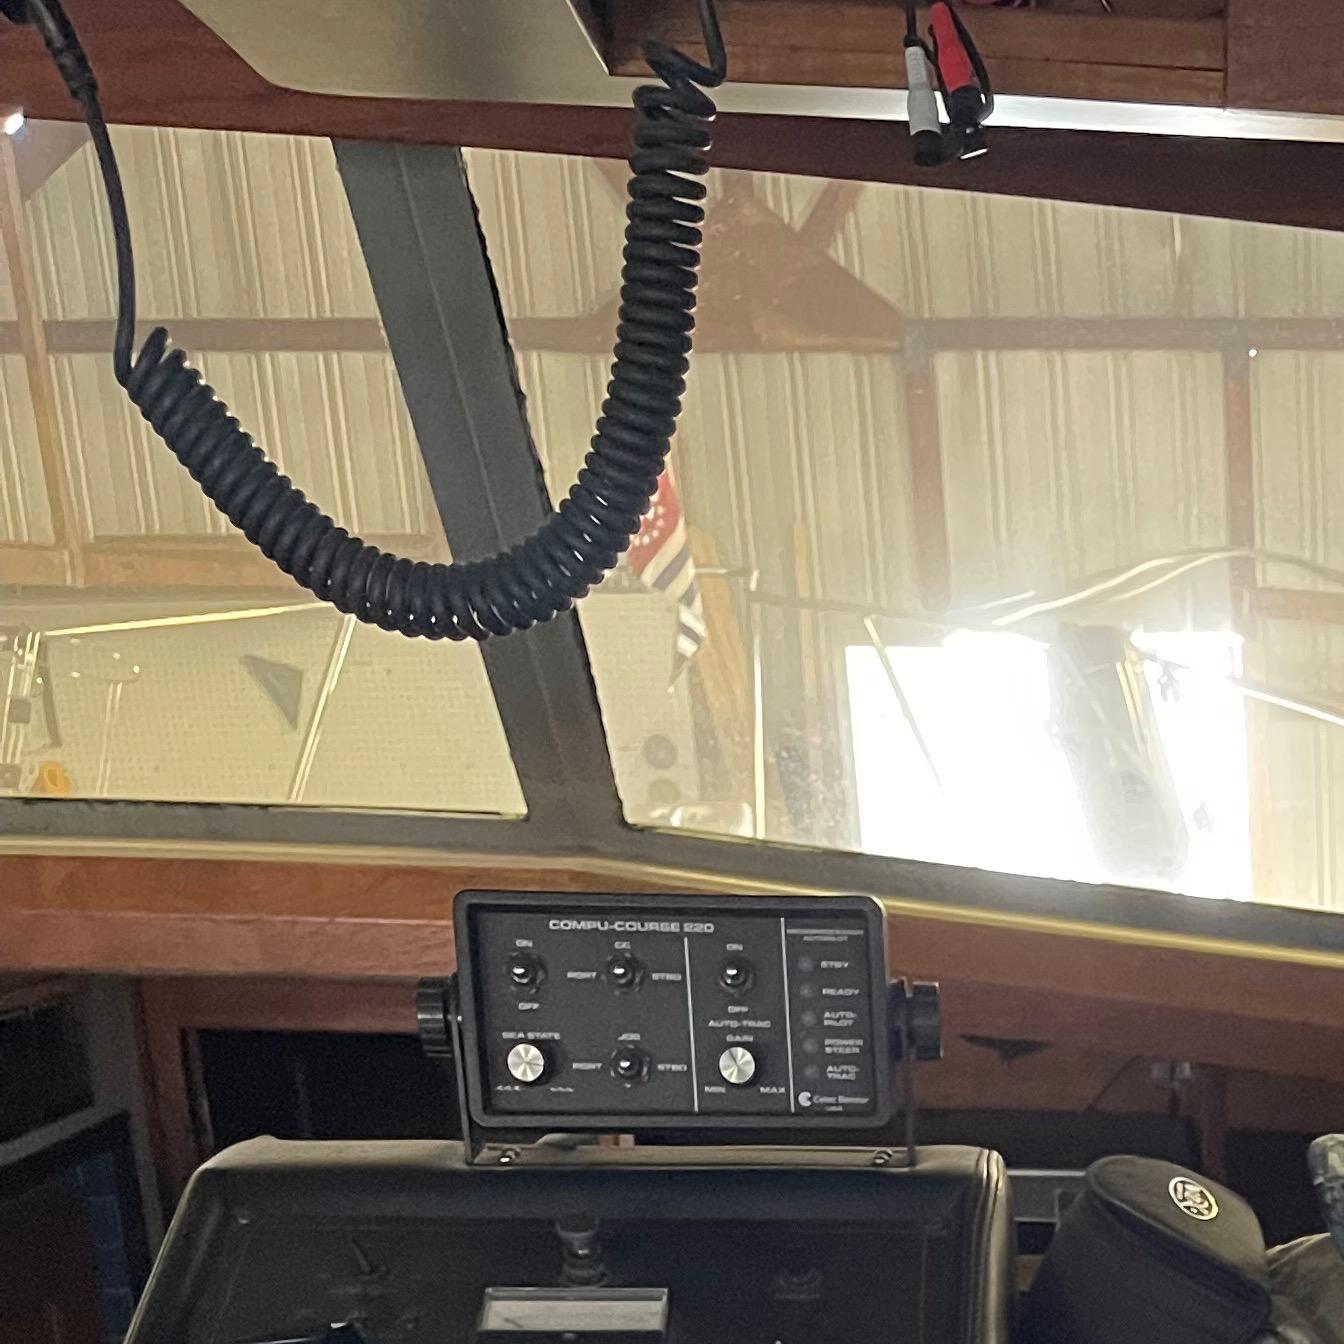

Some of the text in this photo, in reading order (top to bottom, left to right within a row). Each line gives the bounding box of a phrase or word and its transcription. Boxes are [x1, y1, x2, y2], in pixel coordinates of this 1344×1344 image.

[549, 919, 714, 933] COMPU-COURSE 220
[822, 987, 859, 996] READY
[502, 1031, 561, 1040] SEA STATE
[704, 1085, 726, 1093] MIN
[759, 1086, 786, 1094] MAX
